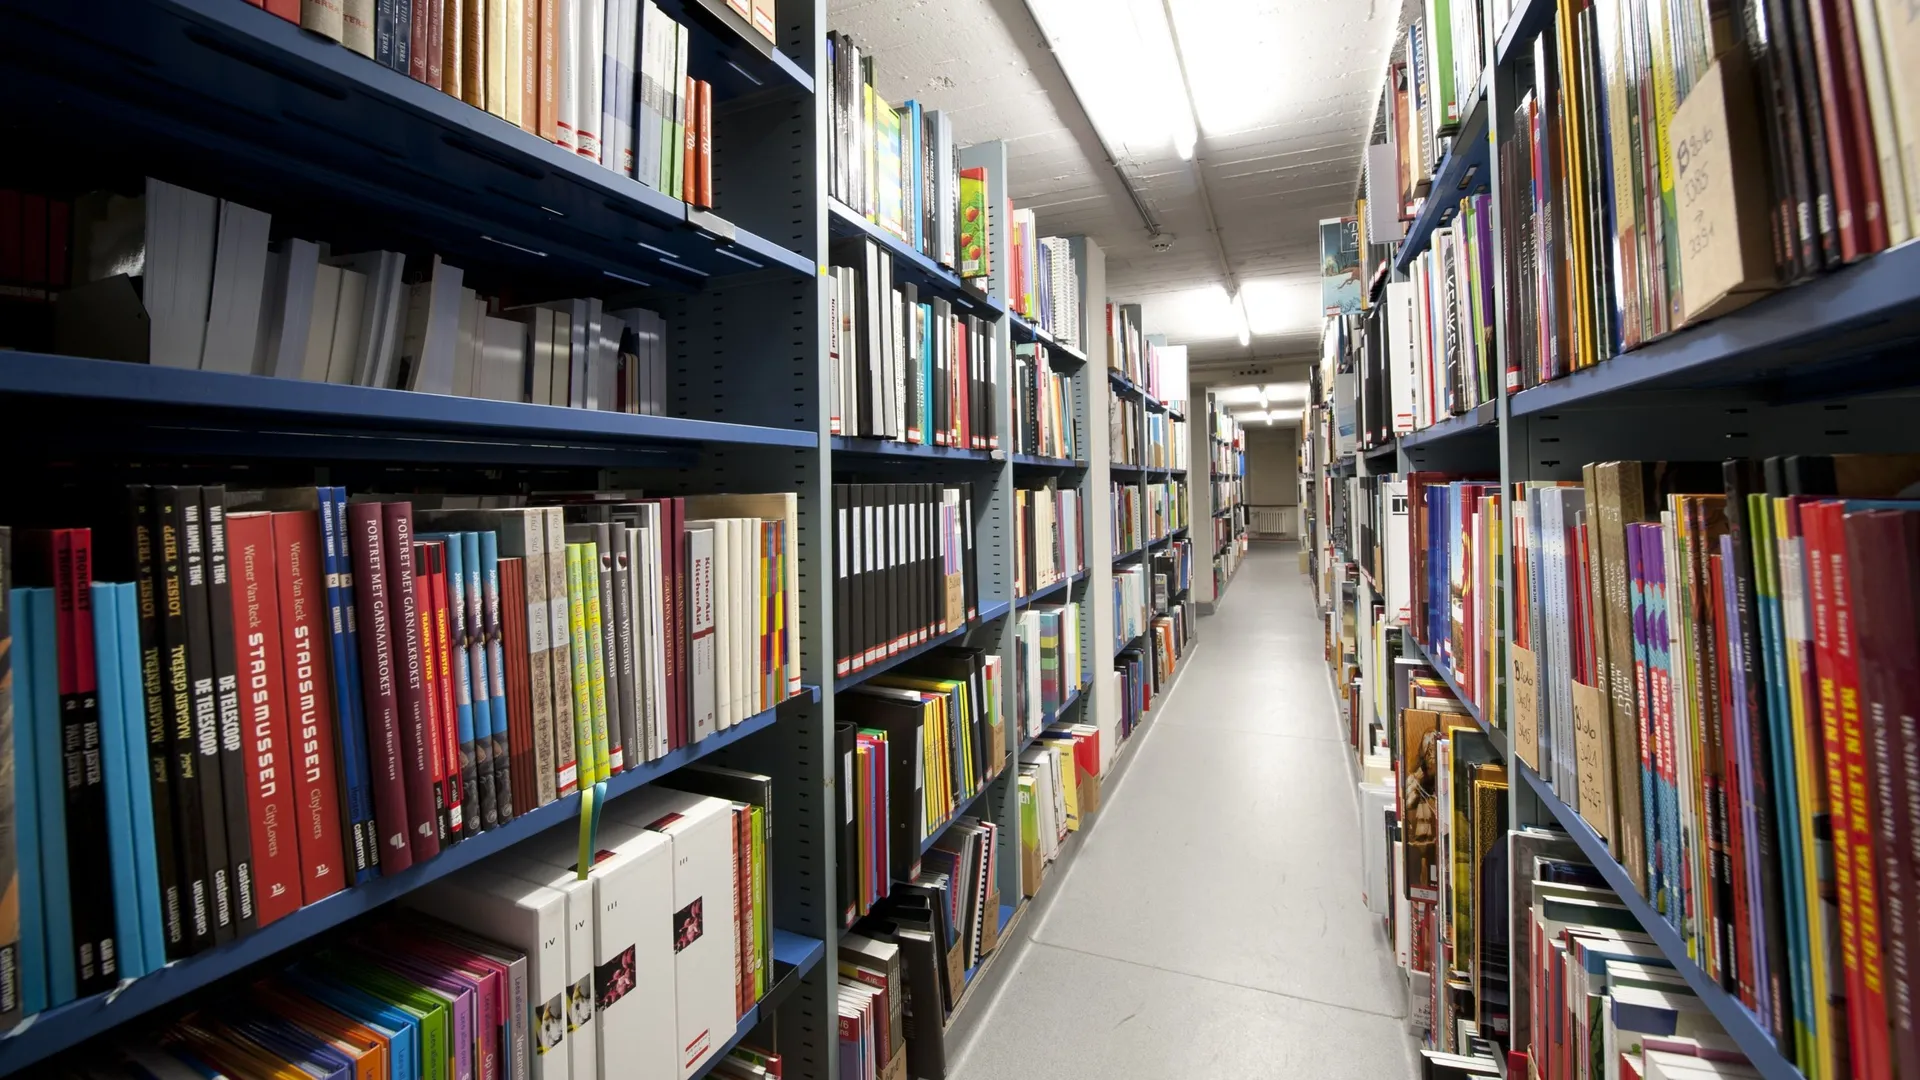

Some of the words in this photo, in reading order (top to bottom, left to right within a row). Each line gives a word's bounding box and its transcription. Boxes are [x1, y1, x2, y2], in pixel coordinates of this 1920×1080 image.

[185, 506, 198, 521] VAN
[210, 506, 223, 521] VAN
[137, 525, 150, 562] TRIPP
[164, 525, 178, 562] TRIPP
[186, 524, 200, 553] HAMME
[211, 525, 224, 553] HAMME
[367, 519, 380, 570] PORTRET
[396, 518, 409, 568] PORTRET
[190, 565, 202, 585] TENG
[213, 565, 226, 584] TENG
[244, 545, 256, 579] Werner
[290, 541, 301, 575] Werner
[1811, 550, 1825, 600] Richard
[77, 548, 91, 612] TRONCHET
[141, 573, 155, 618] LOISEL
[168, 574, 181, 617] LOISEL
[246, 581, 258, 604] Van
[291, 577, 303, 598] Van
[370, 573, 383, 597] MET
[400, 570, 412, 594] MET
[455, 572, 464, 603] Johannes
[472, 571, 482, 602] Johannes
[489, 569, 499, 600] Johannes
[694, 559, 703, 626] KitchenAid
[703, 556, 711, 624] KitchenAid
[1831, 554, 1848, 606] Richard
[248, 605, 260, 628] Reck
[293, 599, 305, 621] Reck
[436, 602, 446, 638] TRAMPAS
[456, 604, 466, 631] Wickert
[474, 603, 483, 629] Wickert
[491, 601, 500, 626] Wickert
[605, 589, 615, 620] Complete
[621, 588, 630, 617] Complete
[421, 605, 431, 642] TRAMPAS
[575, 620, 585, 643] pure
[590, 616, 601, 640] pure
[1816, 604, 1829, 649] Scarry
[1836, 610, 1851, 657] Scarry
[373, 600, 391, 697] GARNAALKROKET
[403, 597, 420, 690] GARNAALKROKET
[440, 647, 449, 676] PISTAS
[577, 645, 586, 669] eten
[592, 643, 601, 666] eten
[605, 621, 618, 678] Wijncursus
[621, 619, 634, 676] Wijncursus
[1743, 632, 1753, 672] Dufaux
[145, 646, 161, 694] GÉNÉRAL
[171, 645, 188, 693] GÉNÉRAL
[424, 652, 434, 680] PISTAS
[578, 672, 588, 691] van
[593, 669, 603, 687] van
[1597, 657, 1605, 693] Djinn
[195, 678, 211, 698] DE
[218, 675, 235, 696] DE
[294, 625, 321, 783] STADSMUSSEN
[595, 688, 605, 712] Raw
[1615, 669, 1625, 707] Djinn
[1623, 676, 1634, 716] Djinn
[1638, 664, 1646, 708] SUSKE
[1651, 672, 1660, 715] SUSKE
[1660, 676, 1669, 702] BOB
[150, 696, 165, 743] MAGASIN
[177, 695, 191, 740] MAGASIN
[220, 696, 240, 751] TELESCOOP
[248, 632, 277, 798] STADSMUSSEN
[580, 693, 590, 717] Raw
[1820, 677, 1839, 743] MIJN
[1840, 687, 1862, 754] MIJN
[66, 723, 80, 750] PAUL
[83, 721, 98, 748] PAUL
[196, 698, 217, 755] TELESCOOP
[384, 708, 392, 729] Isabel
[389, 757, 398, 781] Arques
[413, 701, 422, 722] Isabel
[418, 750, 427, 773] Arques
[582, 718, 592, 747] Food
[596, 714, 607, 741] Food
[1640, 717, 1649, 759] WISKE
[1662, 713, 1672, 773] BOBETTE
[1654, 725, 1663, 767] WISKE
[64, 751, 81, 789] JESTER
[83, 749, 100, 786] JESTER
[1828, 752, 1847, 819] LEUK
[309, 788, 323, 841] CityLovers
[1847, 765, 1869, 833] LEUK
[264, 804, 279, 858] CityLovers
[354, 823, 367, 870] casterman
[367, 819, 380, 866] casterman
[193, 880, 206, 936] casterman
[215, 869, 230, 927] casterman
[238, 862, 253, 919] casterman
[1834, 829, 1857, 970] WERELDJE
[165, 886, 181, 943] casterman
[575, 920, 585, 931] IV
[1853, 845, 1881, 994] WERELDJE
[545, 937, 556, 949] IV
[0, 947, 16, 1012] casterman
[514, 976, 523, 995] Lees
[485, 1053, 494, 1067] Op
